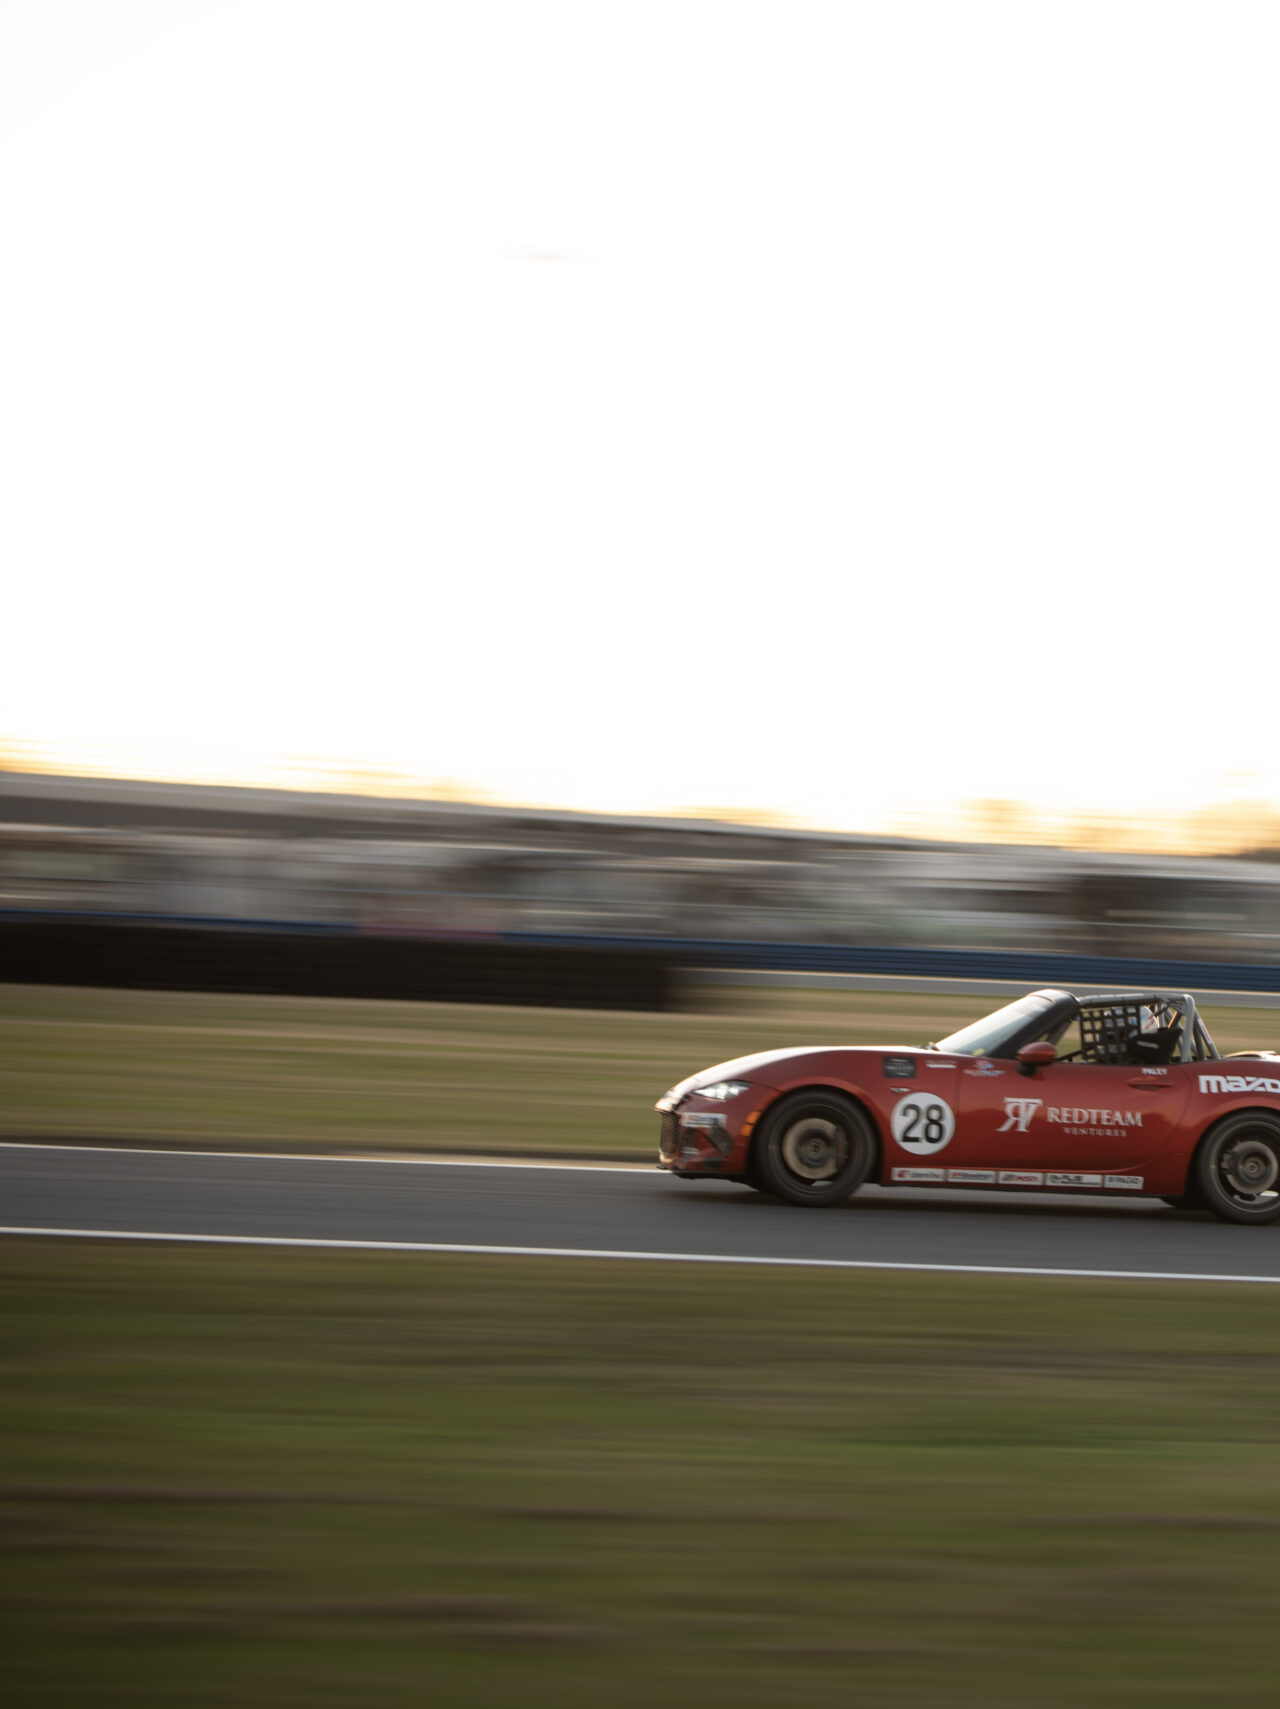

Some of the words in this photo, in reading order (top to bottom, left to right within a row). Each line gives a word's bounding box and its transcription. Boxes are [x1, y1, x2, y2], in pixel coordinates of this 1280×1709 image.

[901, 1104, 946, 1144] 28
[1046, 1107, 1143, 1127] REDTEAM
[1063, 1126, 1127, 1137] VENTURES
